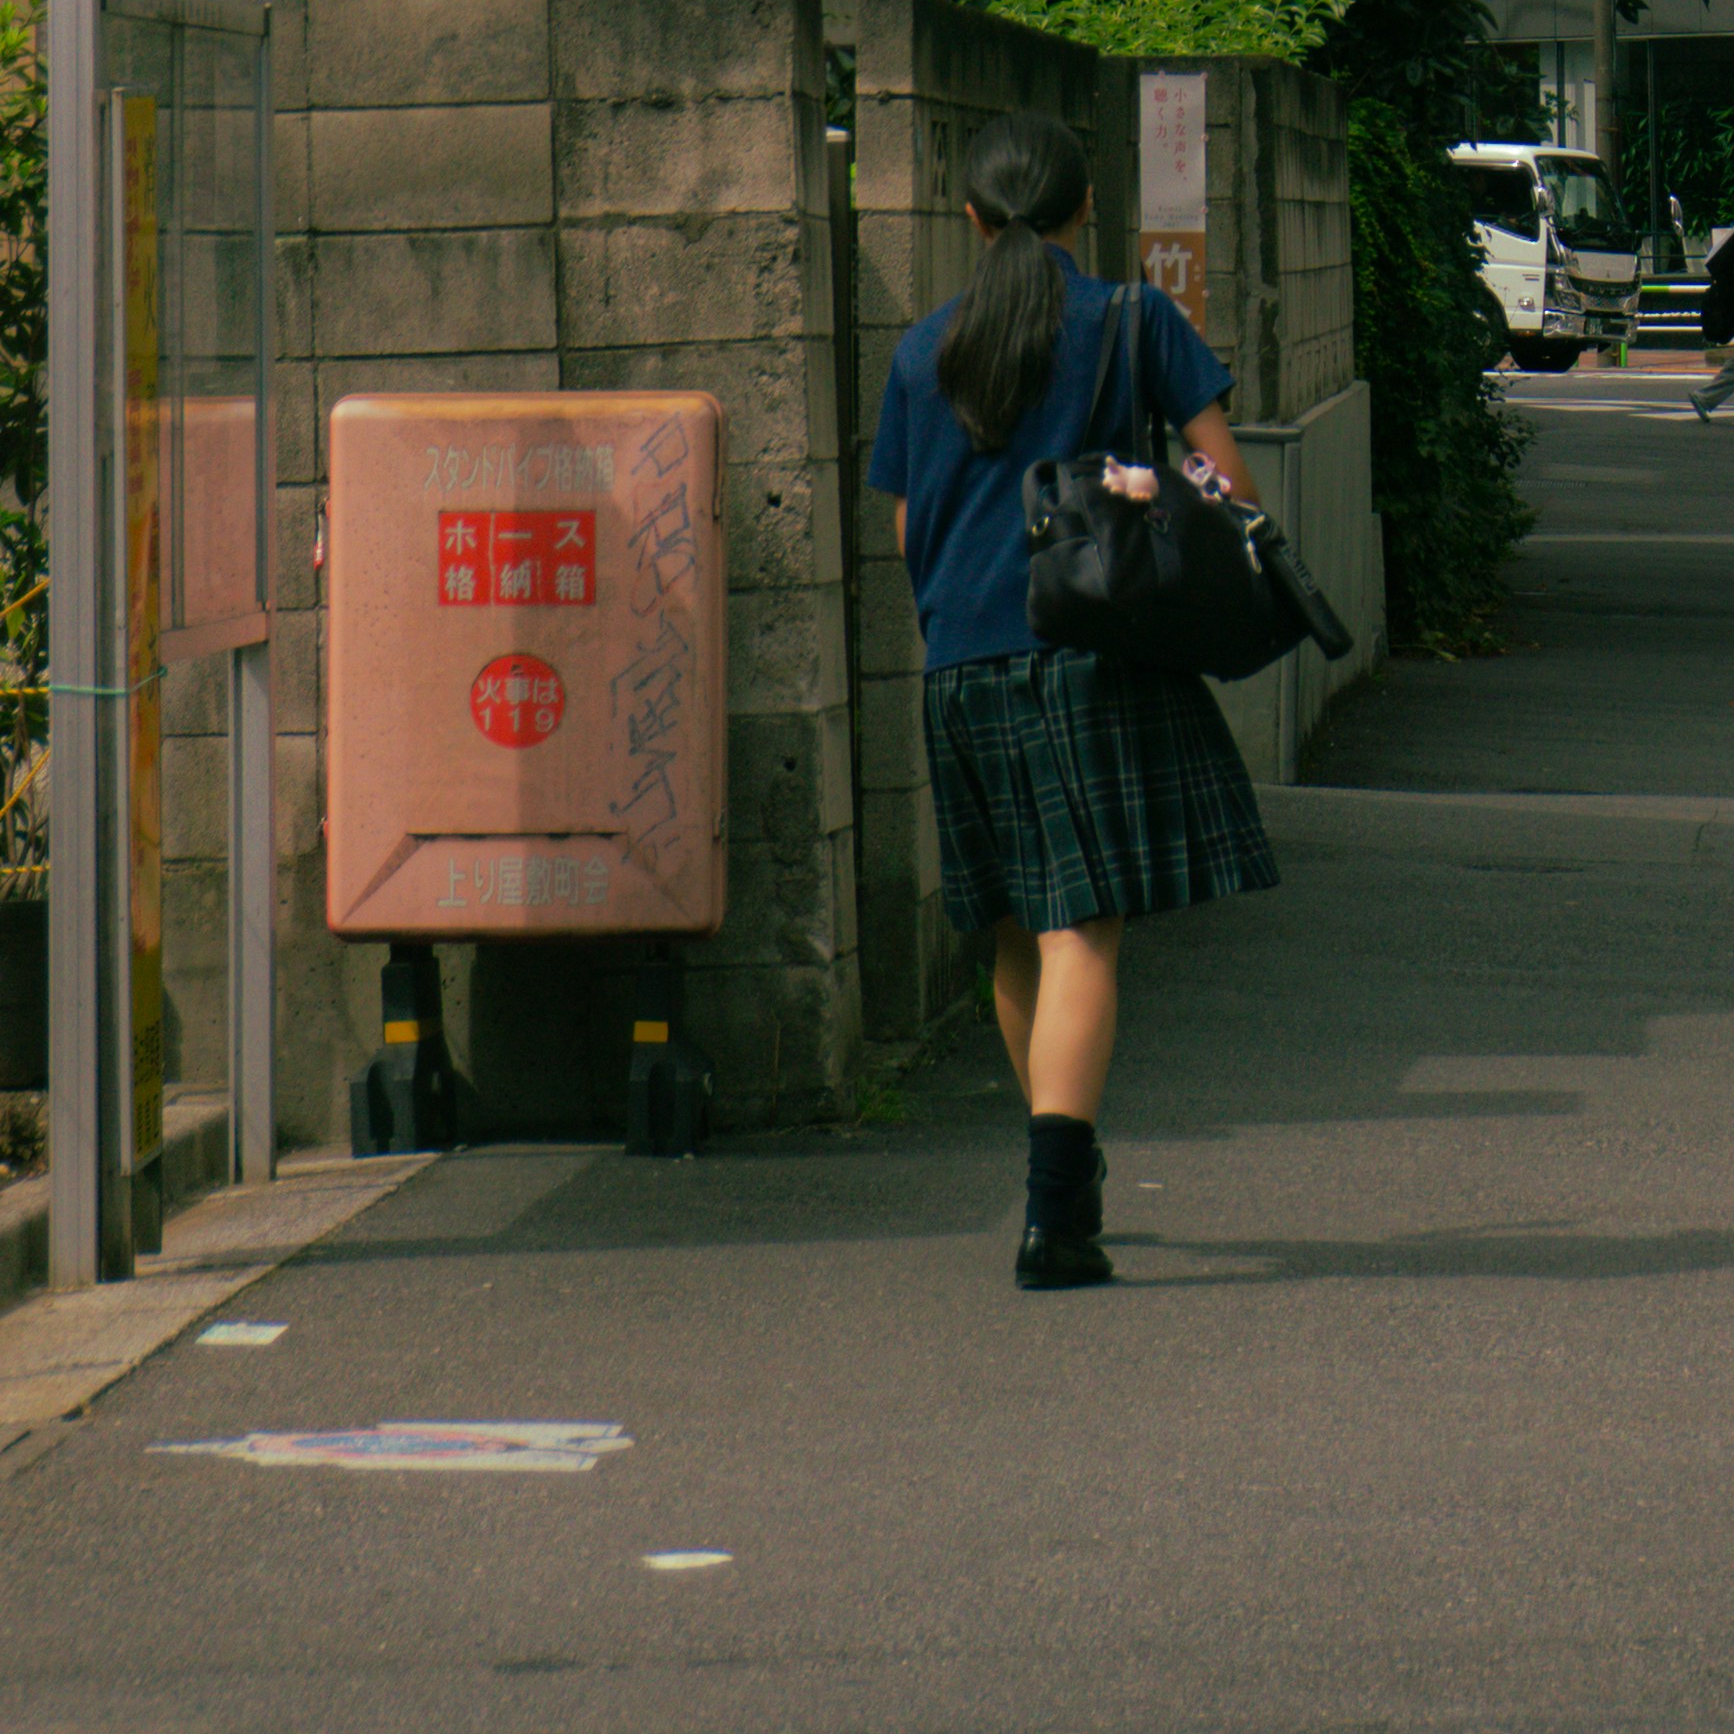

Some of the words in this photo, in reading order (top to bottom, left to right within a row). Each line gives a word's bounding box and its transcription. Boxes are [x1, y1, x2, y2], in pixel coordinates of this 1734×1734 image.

[445, 519, 585, 555] ホース
[445, 560, 586, 601] 格納箱
[477, 678, 559, 707] 火事は
[478, 707, 556, 733] 119
[437, 854, 610, 908] 上り屋敷町会
